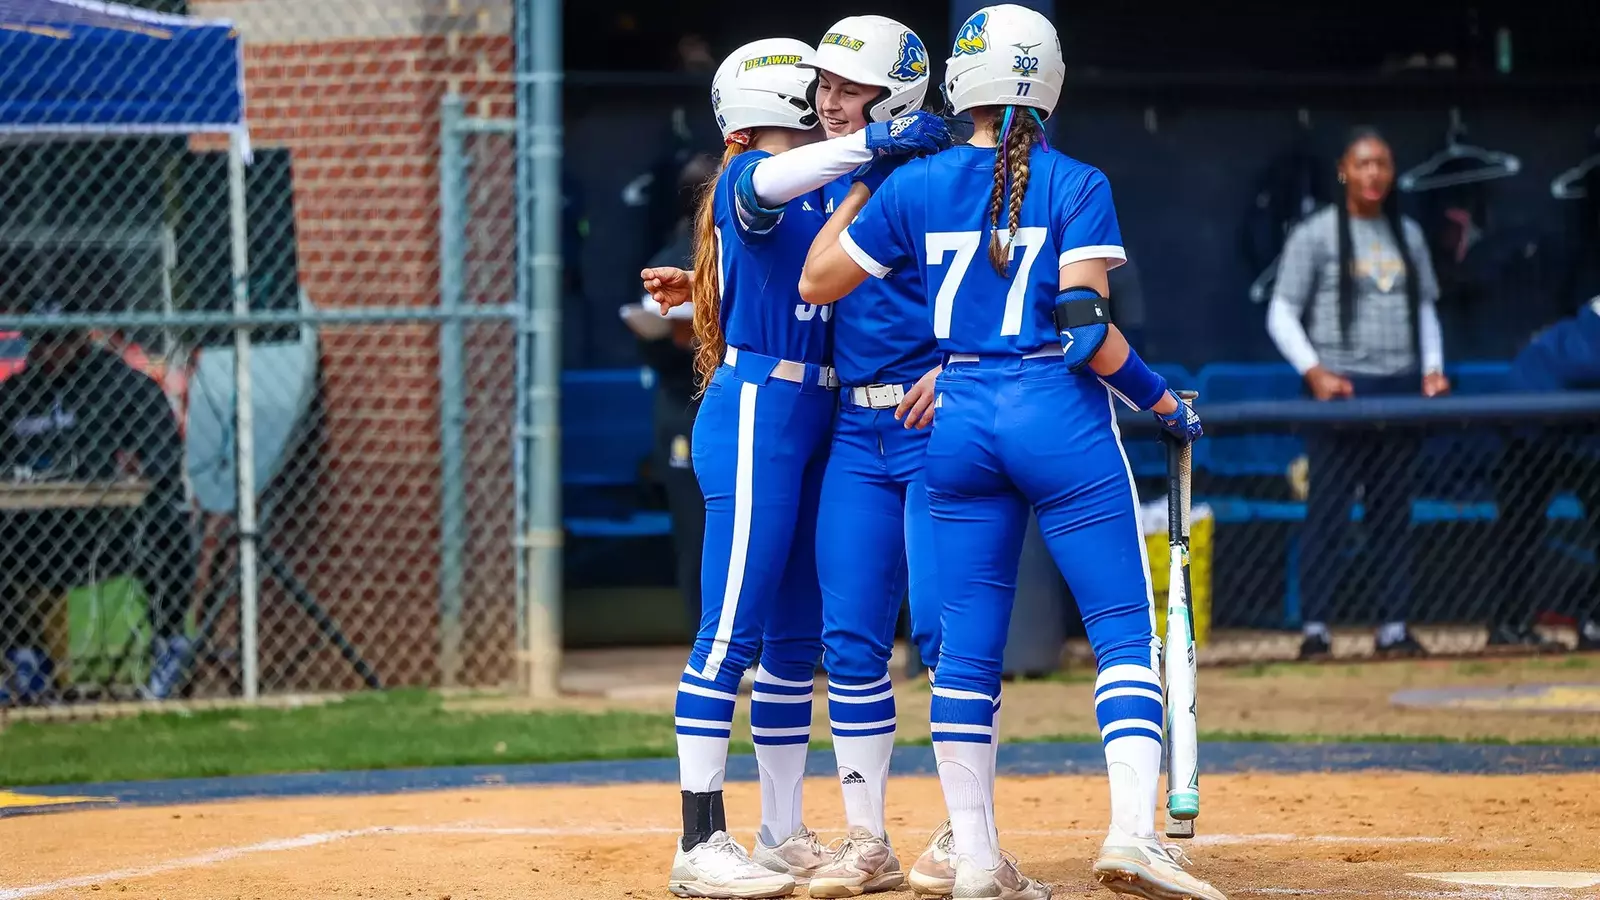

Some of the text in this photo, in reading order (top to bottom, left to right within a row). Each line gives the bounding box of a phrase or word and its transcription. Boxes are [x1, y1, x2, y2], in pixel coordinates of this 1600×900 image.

[838, 35, 864, 51] HENS
[1013, 55, 1039, 70] 302
[1016, 82, 1031, 96] 77
[890, 114, 920, 138] adidas
[925, 226, 1048, 339] 77
